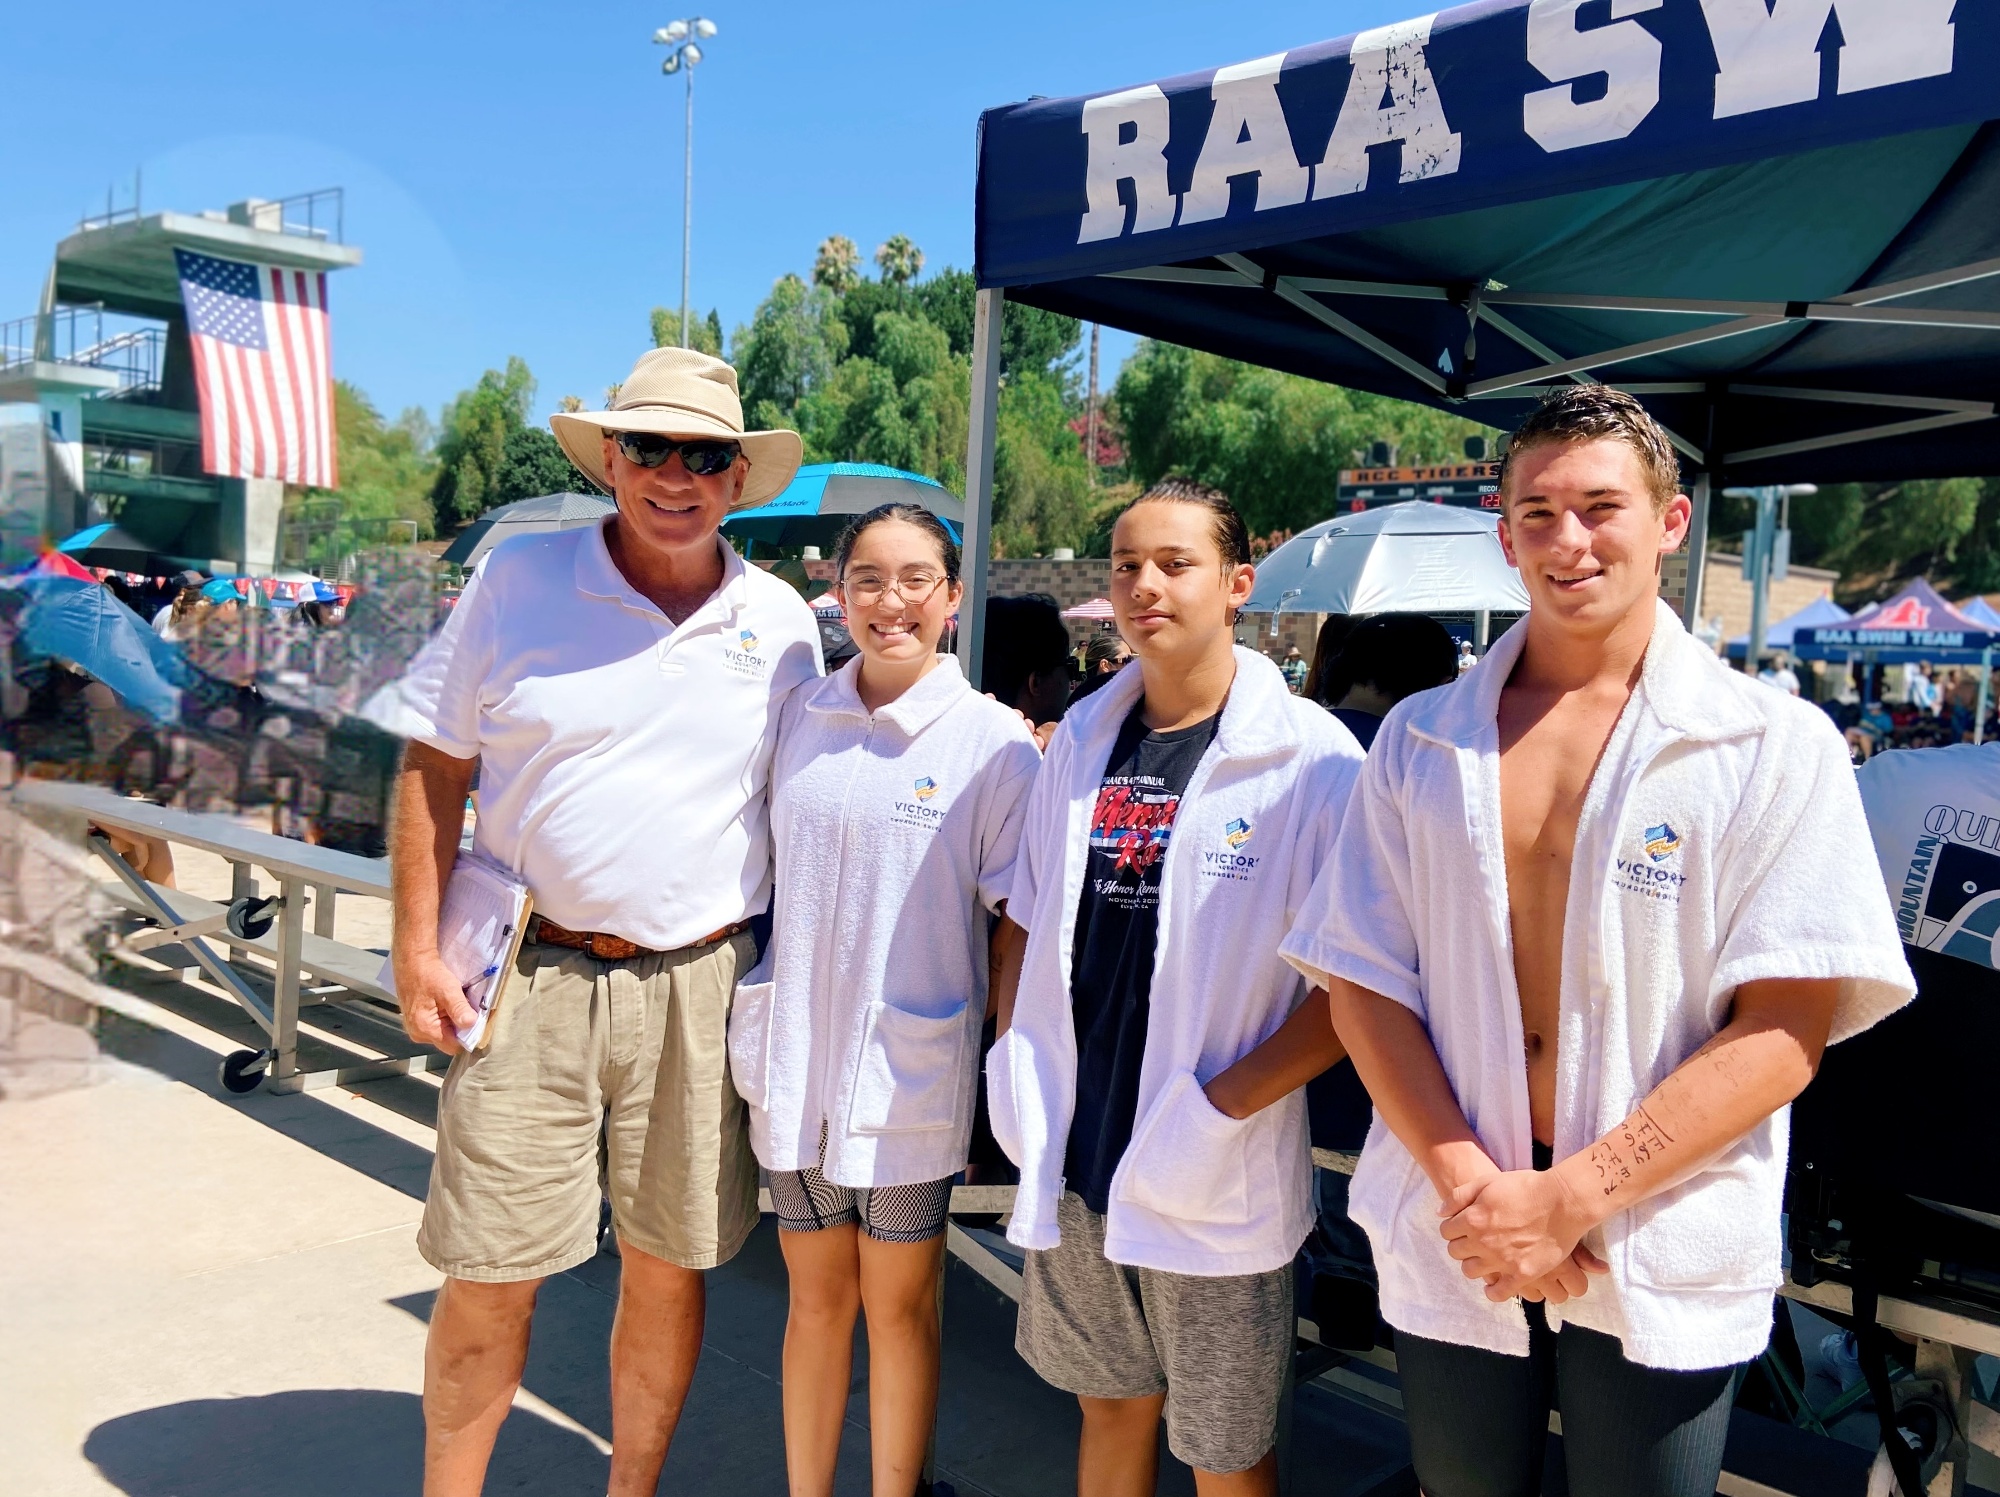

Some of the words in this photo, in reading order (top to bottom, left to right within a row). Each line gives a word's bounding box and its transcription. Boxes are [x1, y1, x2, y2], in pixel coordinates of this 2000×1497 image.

[1077, 11, 1461, 244] RAA
[1412, 464, 1500, 479] TIGERS
[1814, 630, 1852, 644] RAA
[1856, 631, 1907, 645] SWIM
[1910, 632, 1964, 646] TEAM
[725, 649, 767, 668] VICTORY
[894, 802, 946, 820] VICTORY
[1924, 804, 2000, 850] QUI
[1616, 858, 1687, 887] VICTORY
[1897, 834, 1940, 942] MOUNTAIN
